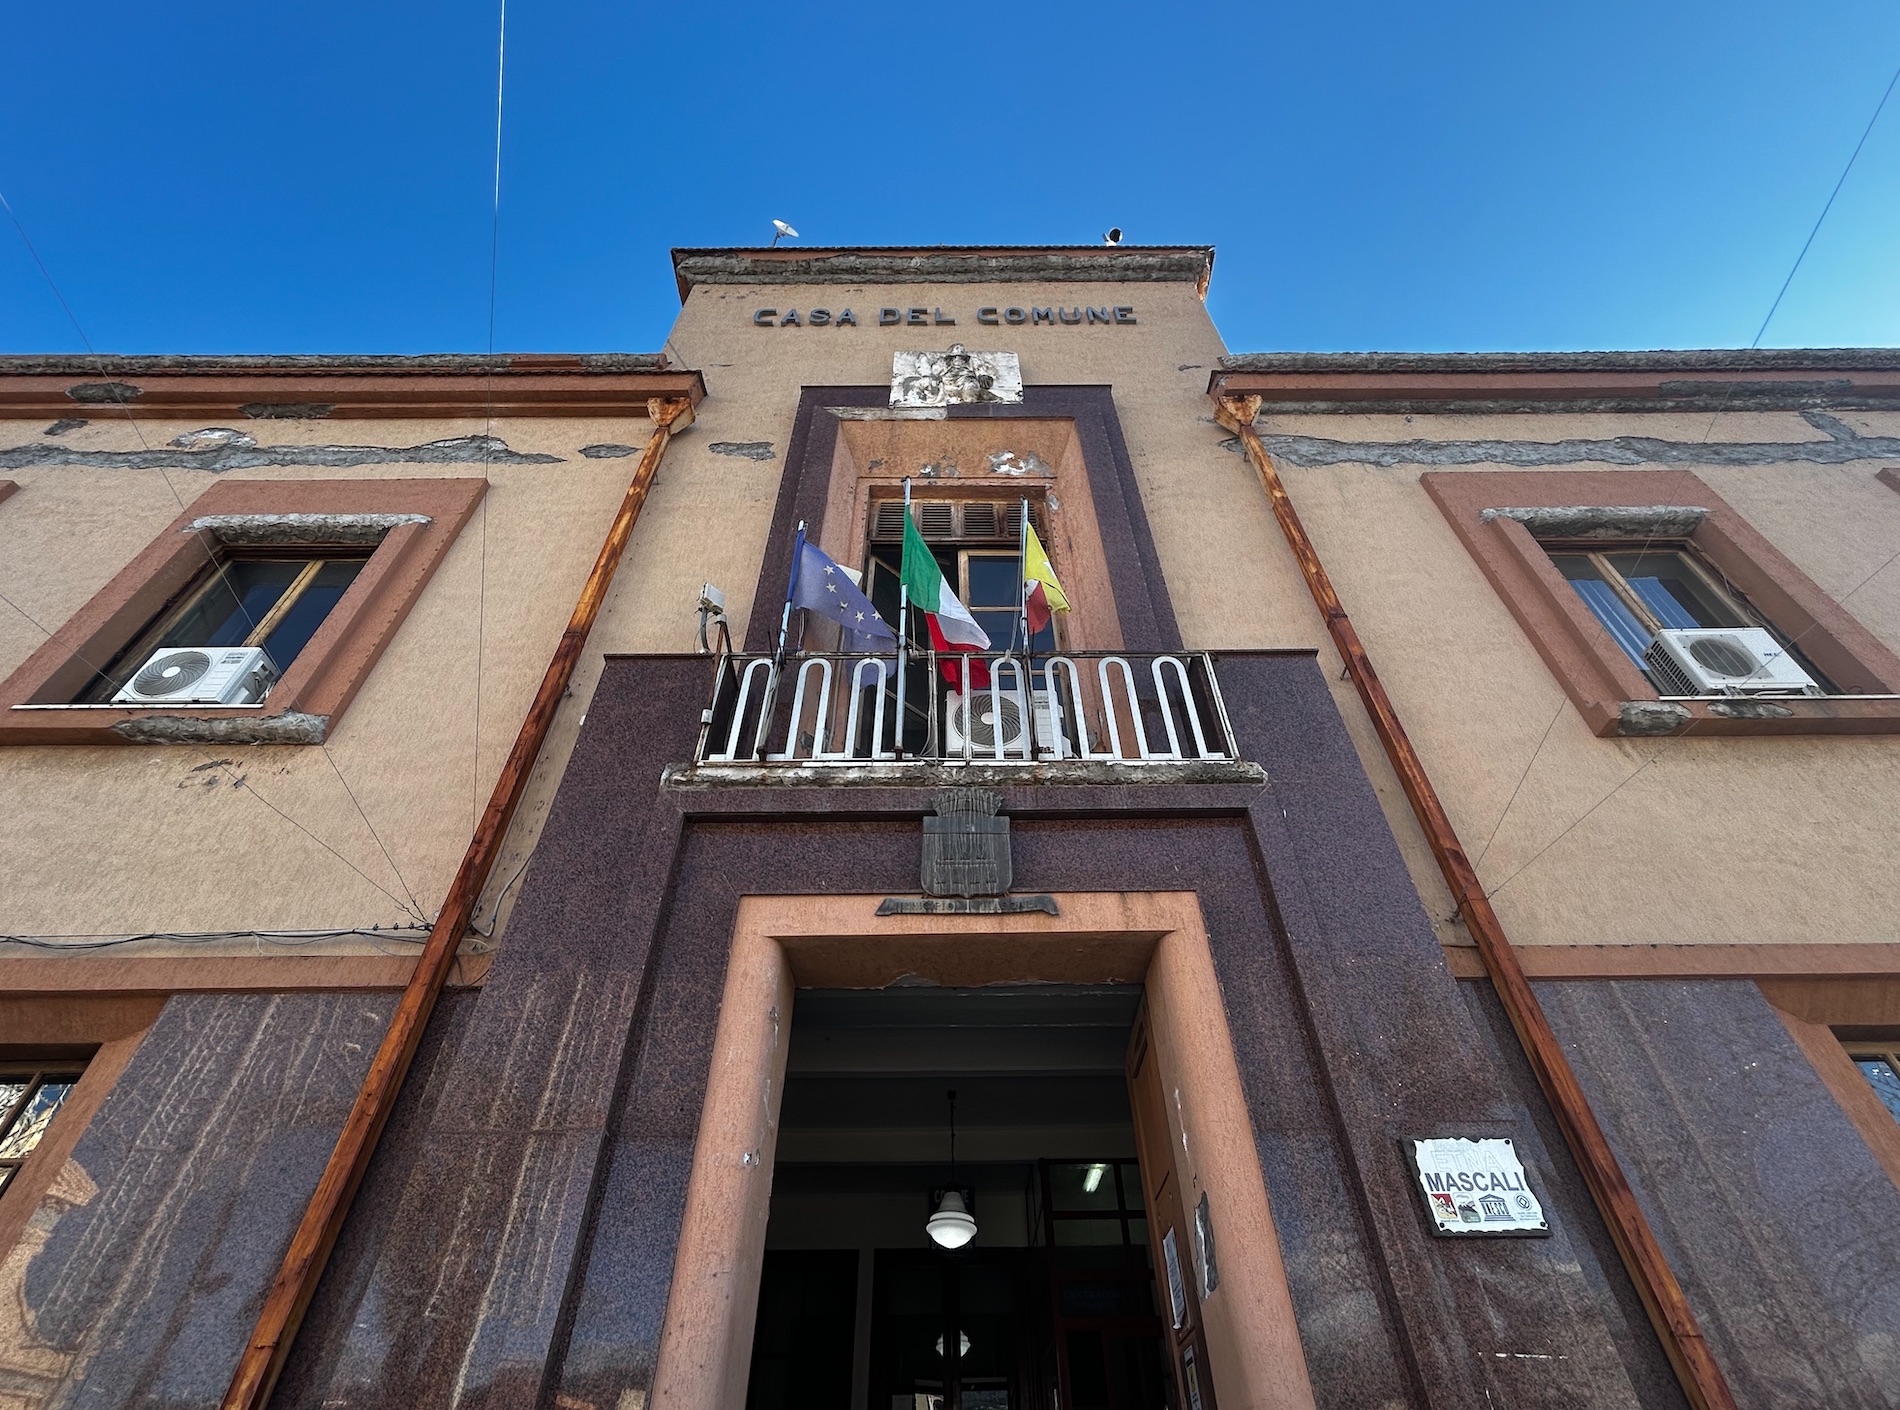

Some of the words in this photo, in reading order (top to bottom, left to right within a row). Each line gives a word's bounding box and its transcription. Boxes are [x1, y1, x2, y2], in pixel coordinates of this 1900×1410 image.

[753, 307, 857, 327] CASA
[879, 307, 956, 326] DEL
[977, 306, 1137, 326] COMUNE
[1431, 1150, 1506, 1173] ETNA
[1424, 1171, 1525, 1192] MASCALI
[1480, 1202, 1510, 1215] UNESCO
